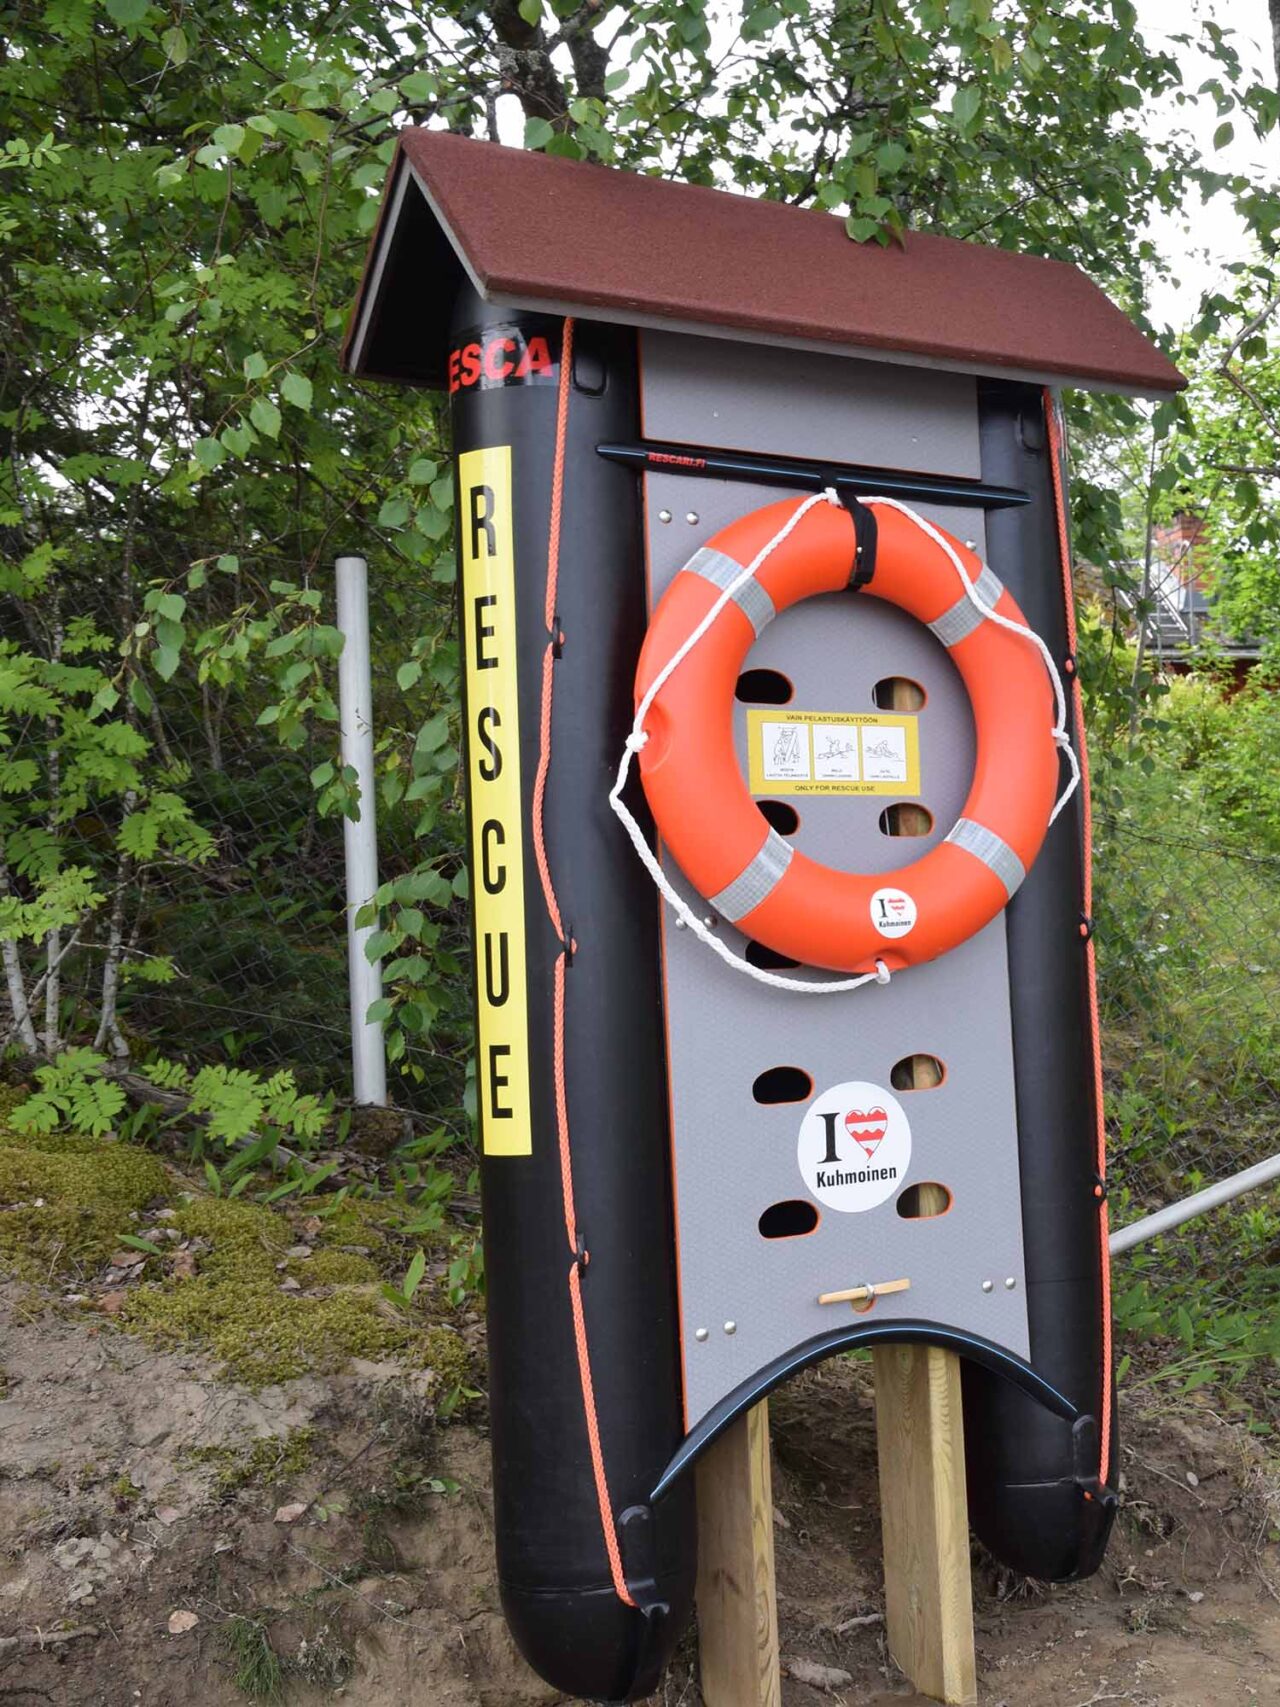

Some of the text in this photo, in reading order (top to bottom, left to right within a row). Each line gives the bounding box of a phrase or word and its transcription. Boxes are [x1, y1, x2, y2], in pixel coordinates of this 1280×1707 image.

[470, 484, 513, 1120] RESCUE
[815, 1112, 843, 1164] I
[816, 1165, 897, 1188] Kuhmoinen
